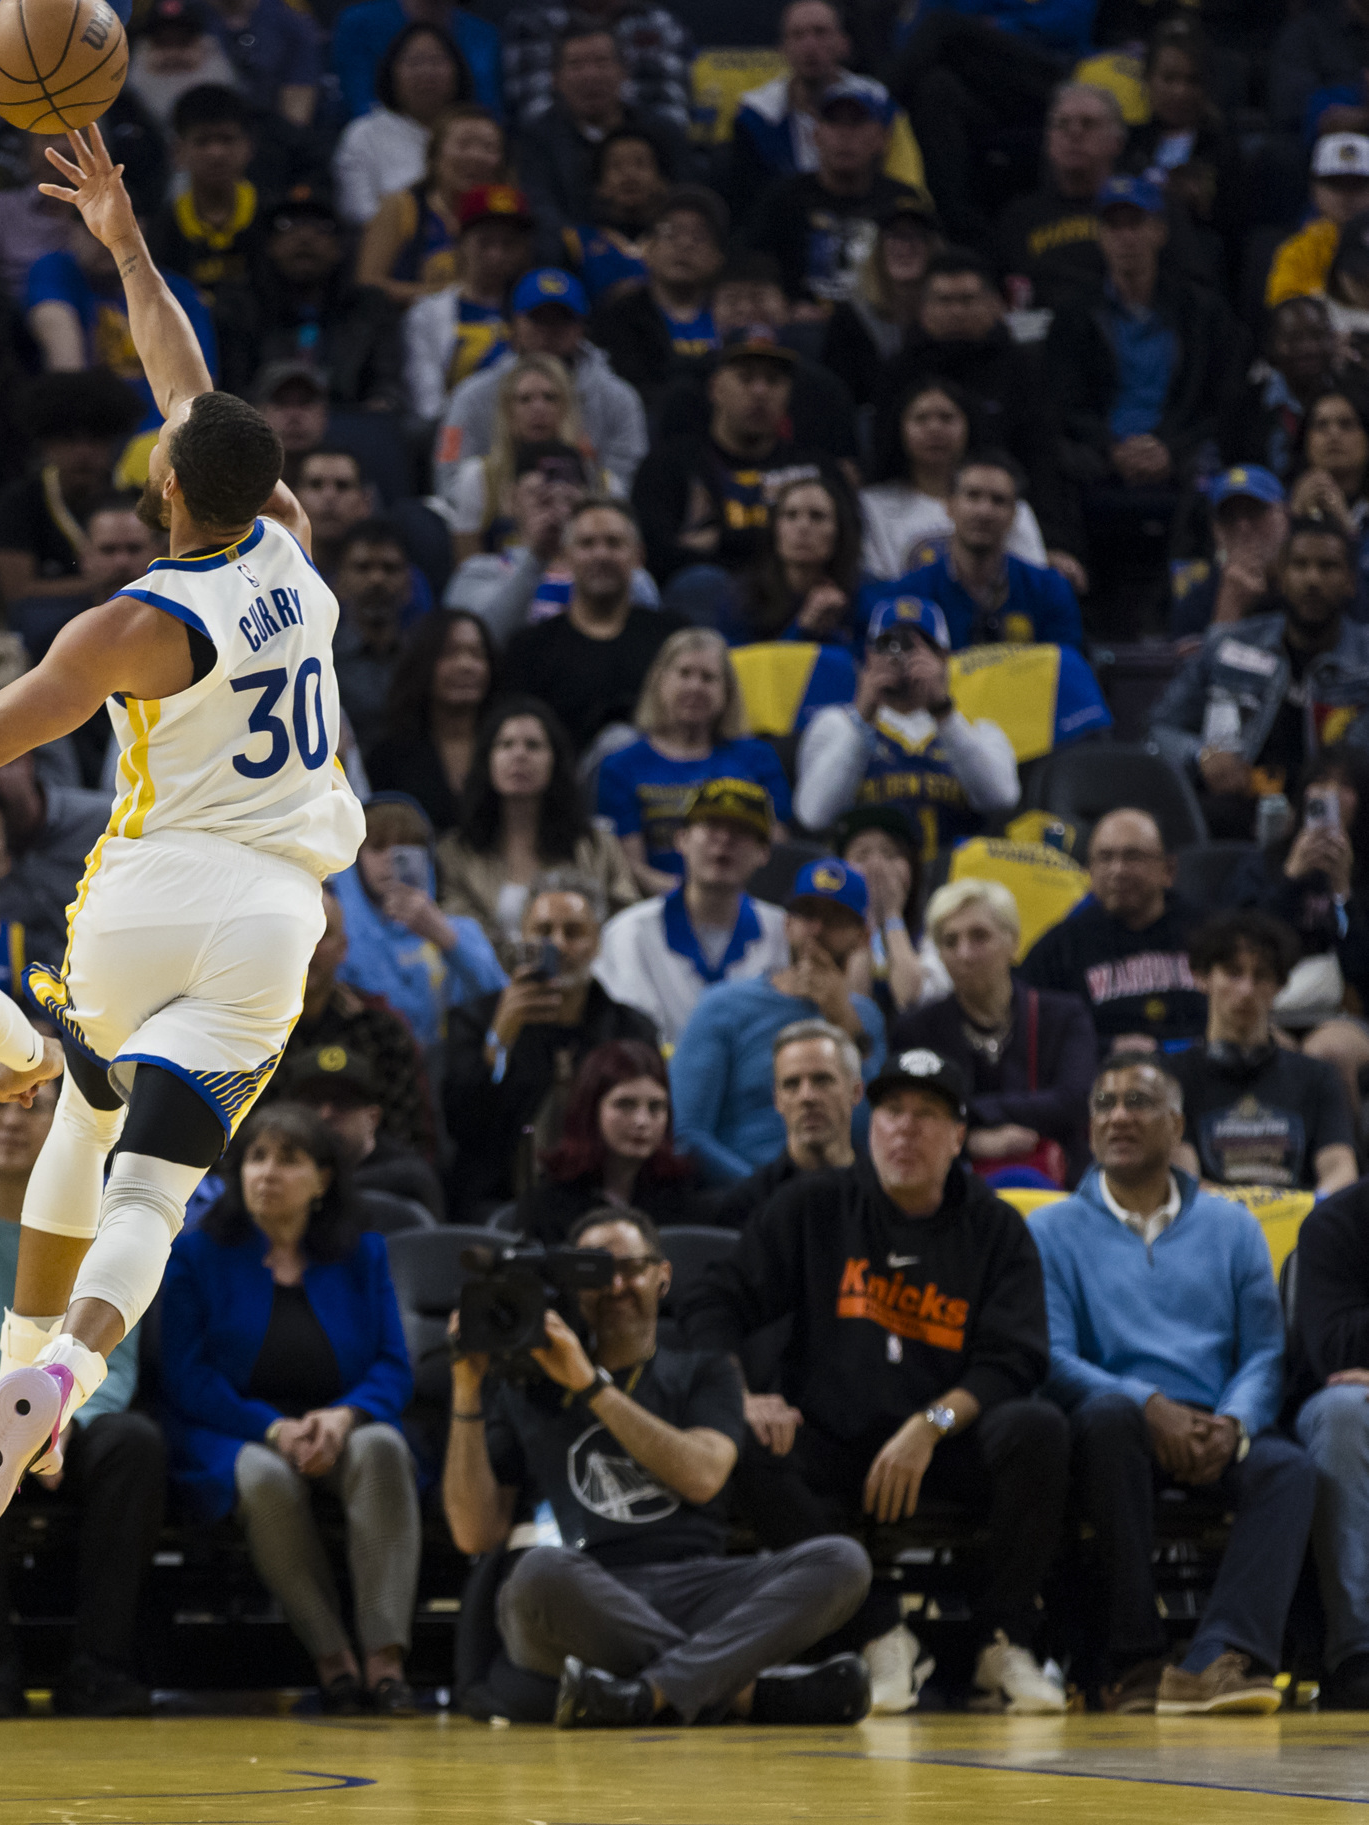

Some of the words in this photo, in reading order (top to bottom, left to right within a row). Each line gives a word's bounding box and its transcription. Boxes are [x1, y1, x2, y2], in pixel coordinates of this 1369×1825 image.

[238, 586, 305, 653] CURRY
[229, 656, 329, 780] 30
[838, 1256, 970, 1328] Knicks
